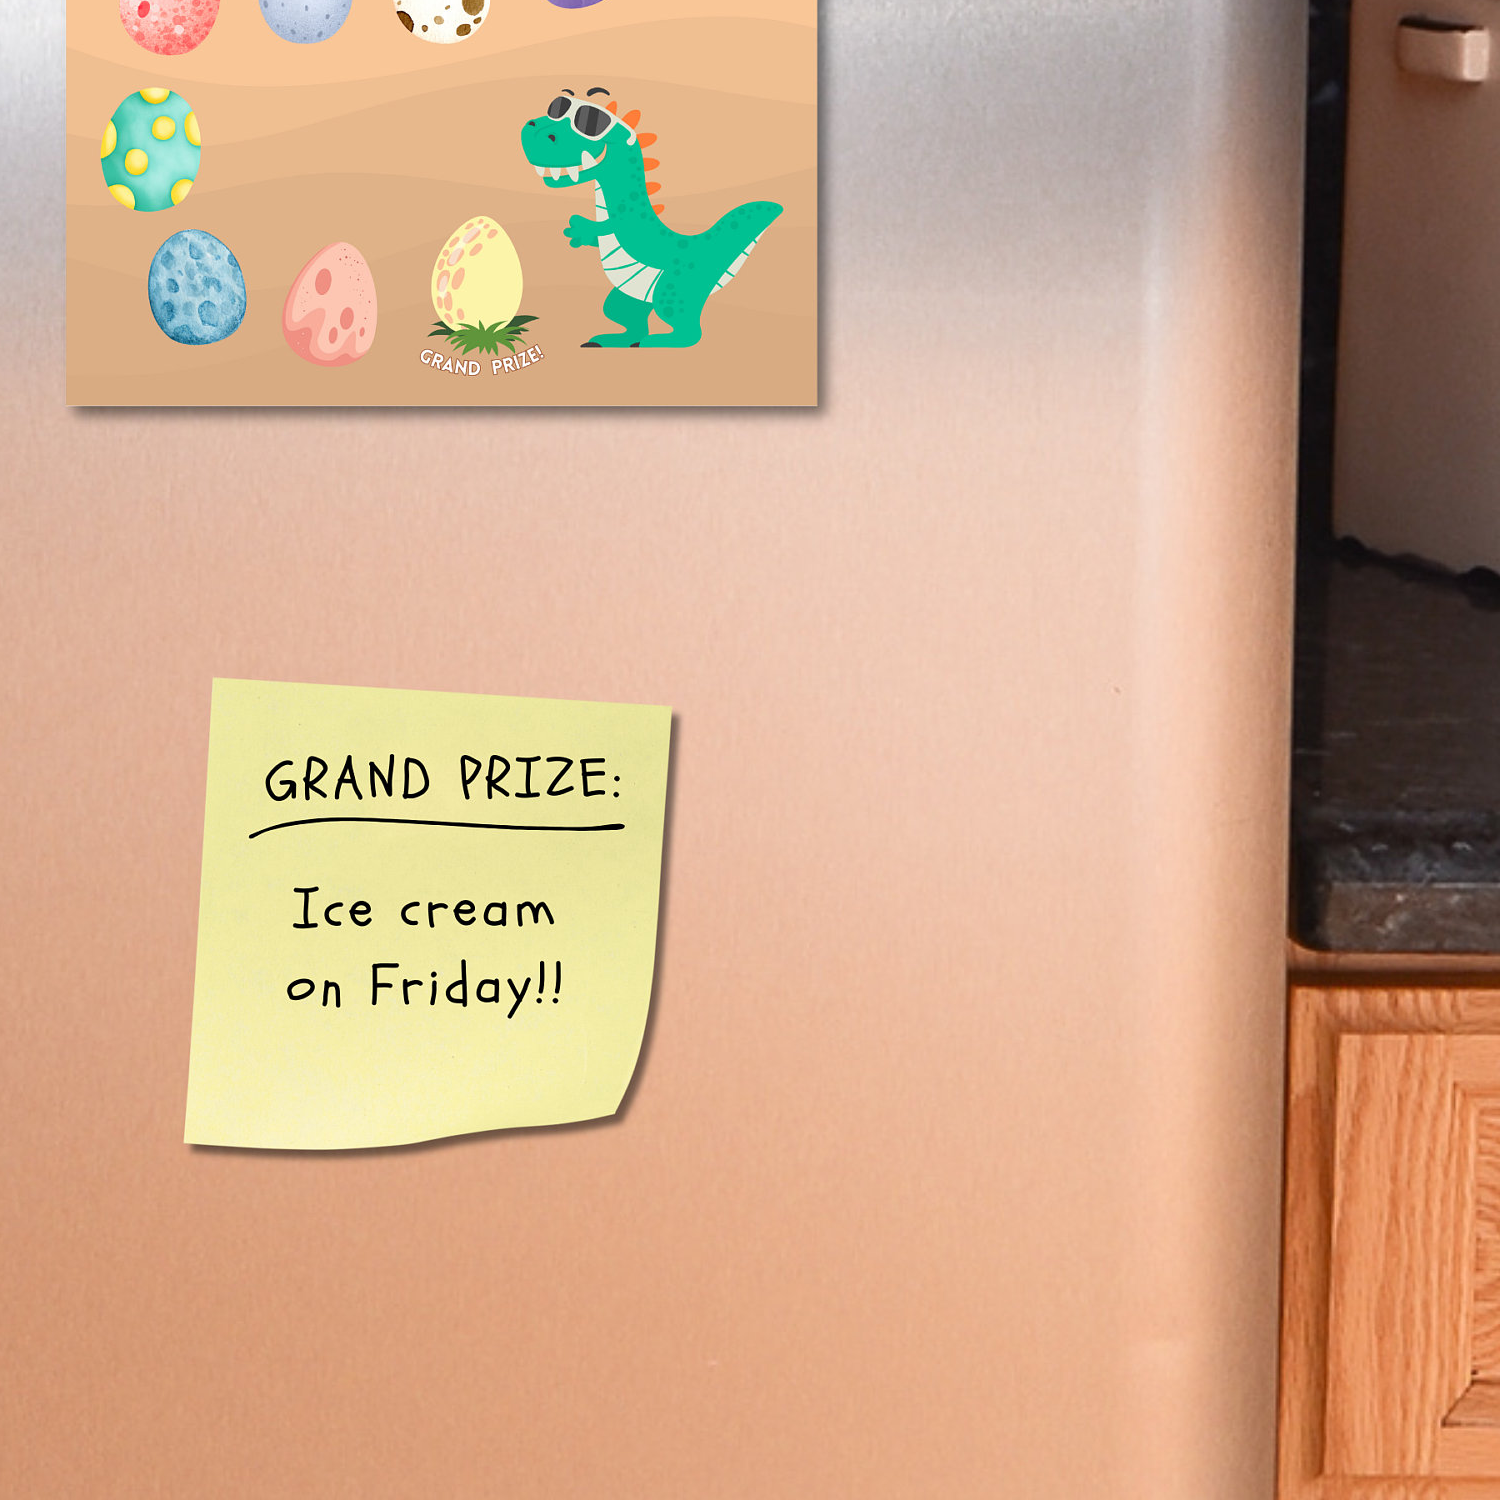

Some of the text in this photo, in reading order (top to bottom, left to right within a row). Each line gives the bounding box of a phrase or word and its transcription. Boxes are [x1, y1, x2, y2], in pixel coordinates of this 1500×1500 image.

[420, 343, 545, 377] GRAND PRIZE!
[265, 753, 622, 802] GRAND PRIZE:
[292, 886, 556, 930] Ice cream
[286, 959, 564, 1020] on Friday!!
